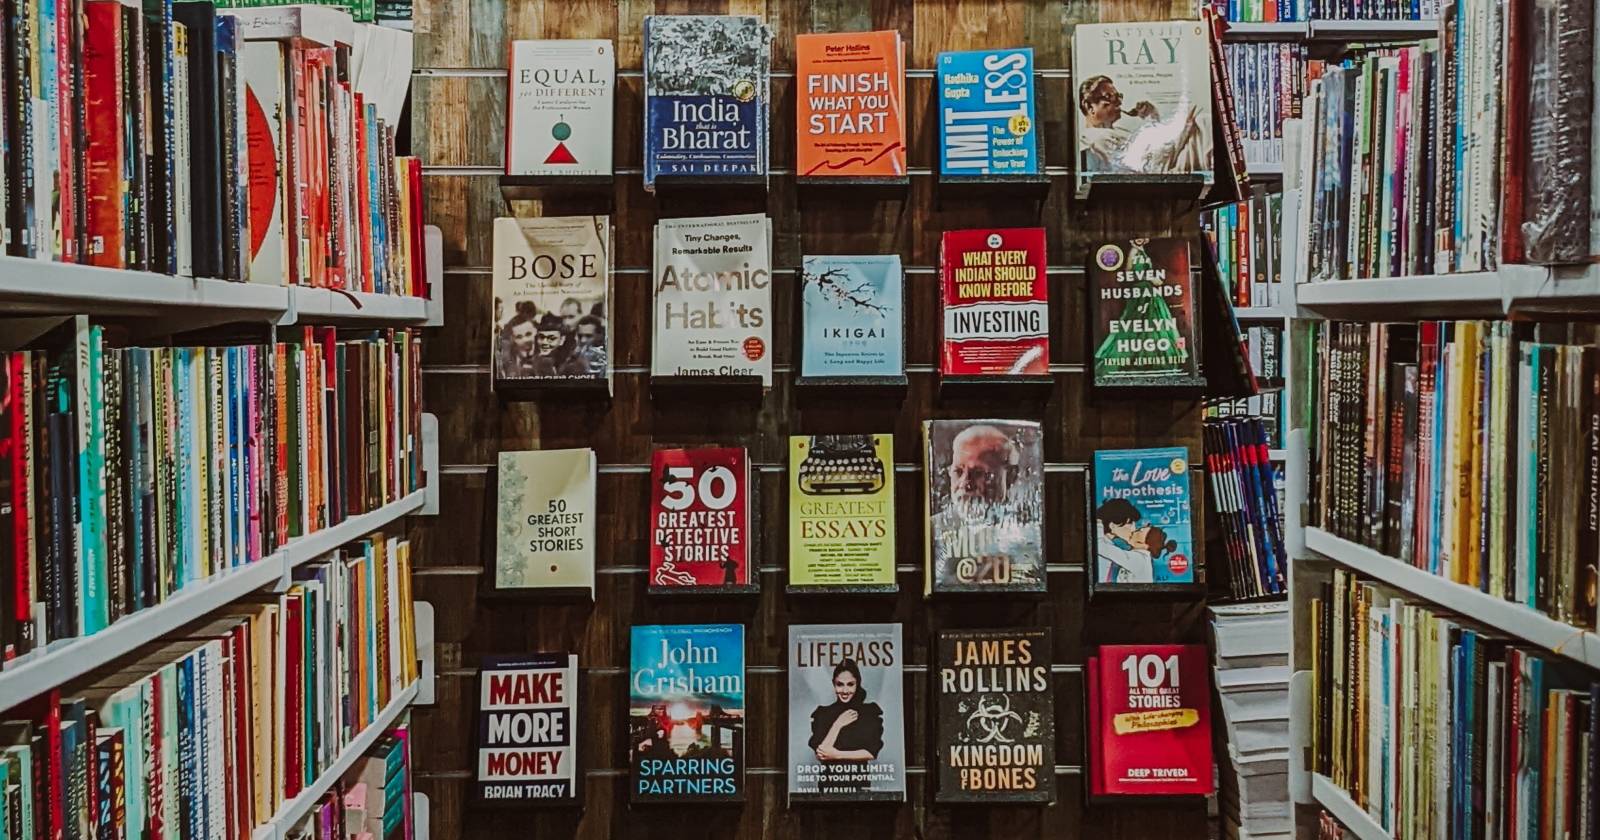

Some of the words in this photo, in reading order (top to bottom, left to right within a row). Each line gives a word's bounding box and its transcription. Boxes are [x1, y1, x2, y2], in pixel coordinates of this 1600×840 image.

[1107, 37, 1182, 66] RAY
[520, 68, 606, 87] EQUAL,
[808, 72, 888, 94] FINISH
[944, 73, 979, 84] Radhika
[536, 88, 606, 97] DIFFERENT
[673, 98, 740, 122] India
[810, 96, 854, 110] WHAT
[858, 95, 888, 109] YOU
[809, 112, 888, 134] START
[662, 125, 750, 150] Bharat
[685, 234, 702, 243] Tiny
[703, 234, 741, 242] Changes,
[672, 247, 720, 255] Remarkable
[722, 244, 753, 254] Results
[963, 252, 992, 266] WHAT
[995, 250, 1028, 266] EVERY
[508, 254, 598, 280] BOSE
[955, 268, 992, 282] INDIAN
[994, 266, 1036, 280] SHOULD
[659, 262, 768, 292] Atomic
[1117, 269, 1166, 282] SEVEN
[959, 284, 991, 298] KNOW
[994, 282, 1033, 297] BEFORE
[1101, 285, 1182, 299] HUSBANDS
[1137, 302, 1149, 314] of
[954, 310, 1040, 334] INVESTING
[1109, 318, 1177, 333] EVELYN
[824, 328, 885, 338] IKIGAI
[1117, 339, 1170, 352] HUGO
[1104, 357, 1130, 366] TAYLOR
[674, 366, 715, 376] James
[719, 366, 754, 376] Clear
[1112, 468, 1129, 482] the
[1131, 460, 1171, 486] Love
[661, 466, 737, 510] 50
[1103, 484, 1183, 499] Hypothesis
[548, 500, 566, 513] 50
[800, 501, 885, 515] GREATEST
[528, 513, 584, 525] GREATEST
[658, 511, 736, 528] GREATEST
[538, 526, 576, 538] SHORT
[656, 528, 739, 545] DETECTIVE
[802, 520, 886, 538] ESSAYS
[530, 538, 584, 552] STORIES
[664, 545, 729, 561] STORIES
[658, 639, 718, 669] John
[797, 641, 894, 667] LIFEPASS
[954, 640, 1032, 666] JAMES
[1122, 654, 1180, 688] 101
[634, 668, 742, 696] Grisham
[942, 666, 1047, 693] ROLLINS
[489, 672, 563, 705] MAKE
[1129, 695, 1181, 708] STORIES
[488, 712, 563, 744] MORE
[487, 751, 562, 776] MONEY
[950, 744, 1043, 767] KINGDOM
[640, 758, 735, 776] SPARRING
[797, 765, 826, 773] DROP
[829, 764, 858, 773] YOUR
[860, 764, 894, 772] LIMITS
[1128, 769, 1150, 777] DEEP
[1152, 768, 1188, 777] TRIVEDI
[639, 778, 736, 794] PARTNERS
[961, 768, 968, 790] OF
[970, 768, 1036, 789] BONES
[484, 786, 522, 799] BRIAN
[526, 784, 565, 798] TRACY
